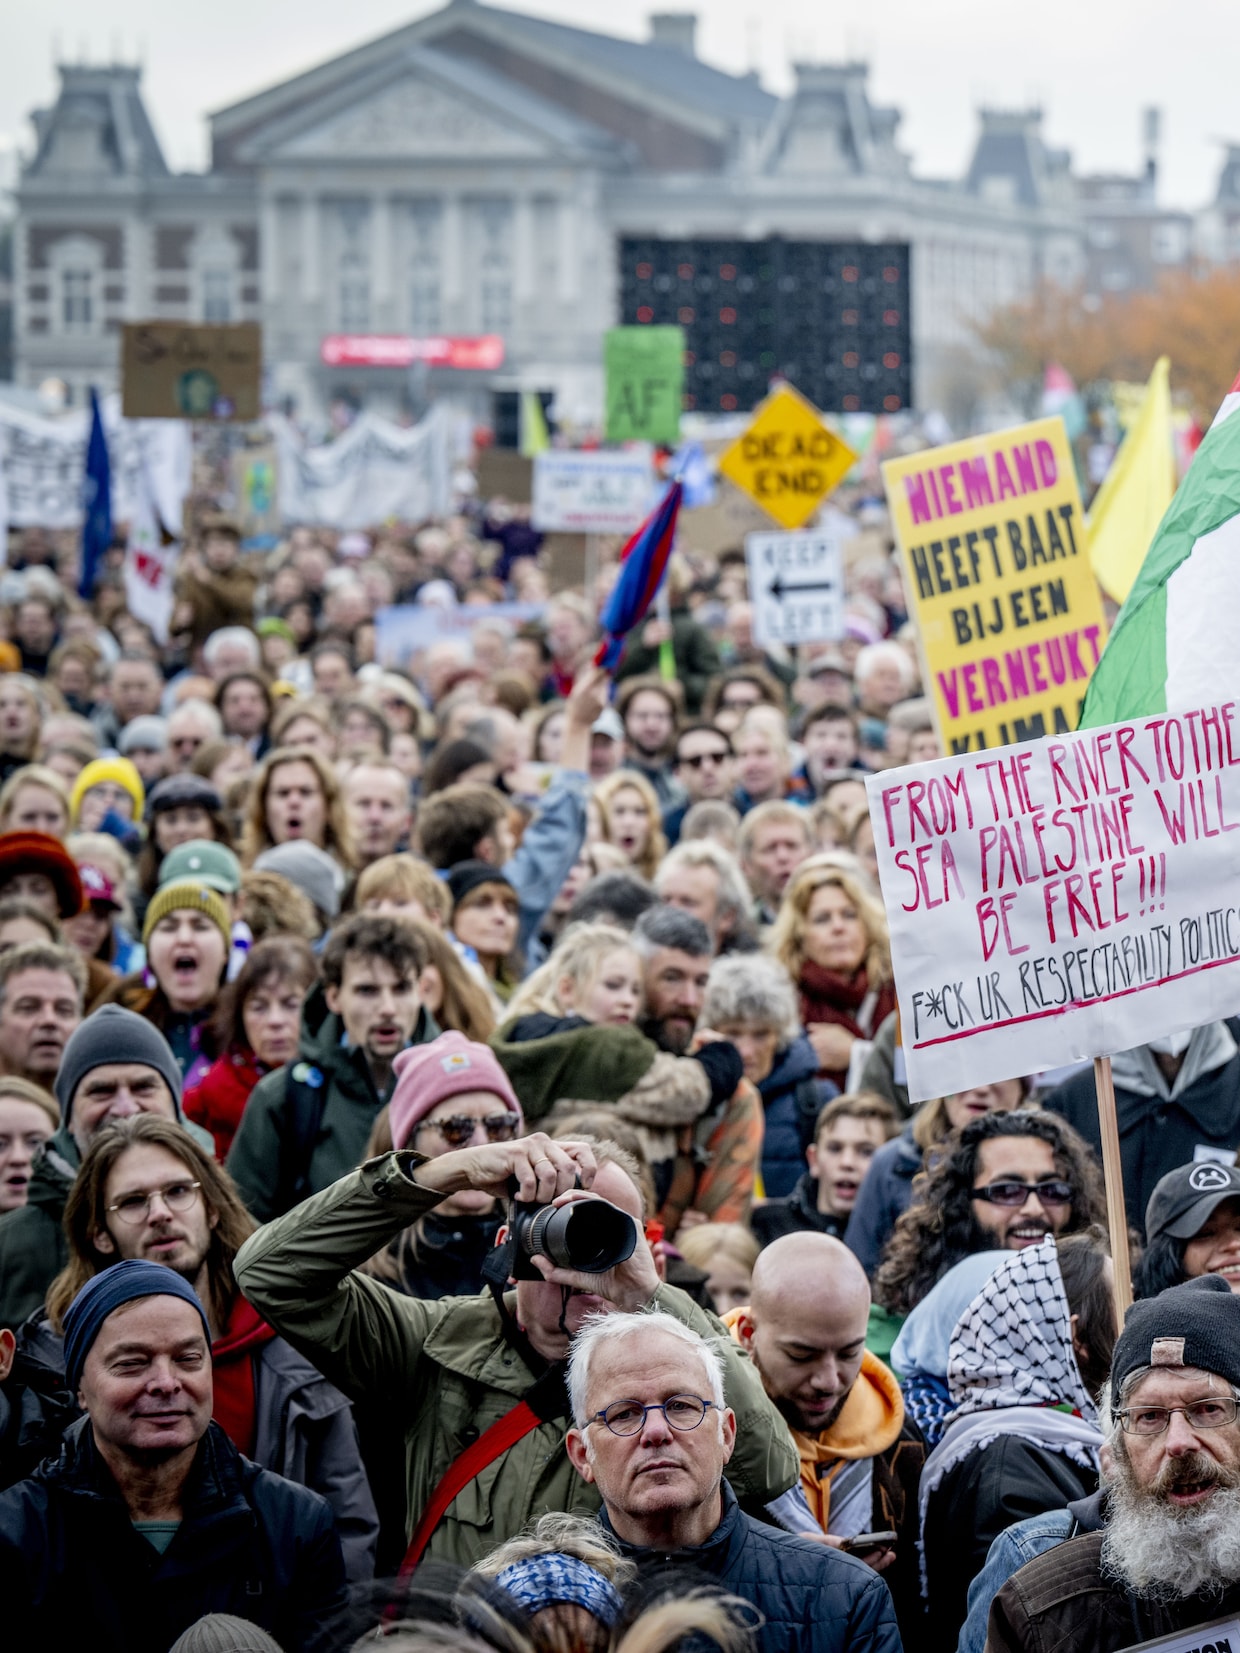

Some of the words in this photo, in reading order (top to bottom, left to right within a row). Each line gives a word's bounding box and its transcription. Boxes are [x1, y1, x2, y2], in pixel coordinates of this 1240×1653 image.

[742, 432, 833, 461] DEAD
[754, 469, 825, 497] END
[904, 439, 1058, 525] NIEMAND
[910, 526, 1002, 599] HEEFT
[1006, 503, 1078, 572] BAAT
[952, 594, 1005, 645] BIJ
[1009, 578, 1069, 628] EEN
[937, 624, 1101, 720] VERNEUKT
[882, 767, 973, 847] FROM
[976, 752, 1045, 822] THE
[1047, 727, 1150, 806] RIVER
[1145, 719, 1185, 784] TO
[895, 839, 965, 912] SEA
[979, 793, 1145, 893] PALESTINE
[1154, 775, 1240, 846] WILL
[976, 891, 1030, 962] BE
[1043, 853, 1166, 944] FREE!!!
[977, 971, 1013, 1022] UR
[1019, 924, 1172, 1013] RESPECTABILITY
